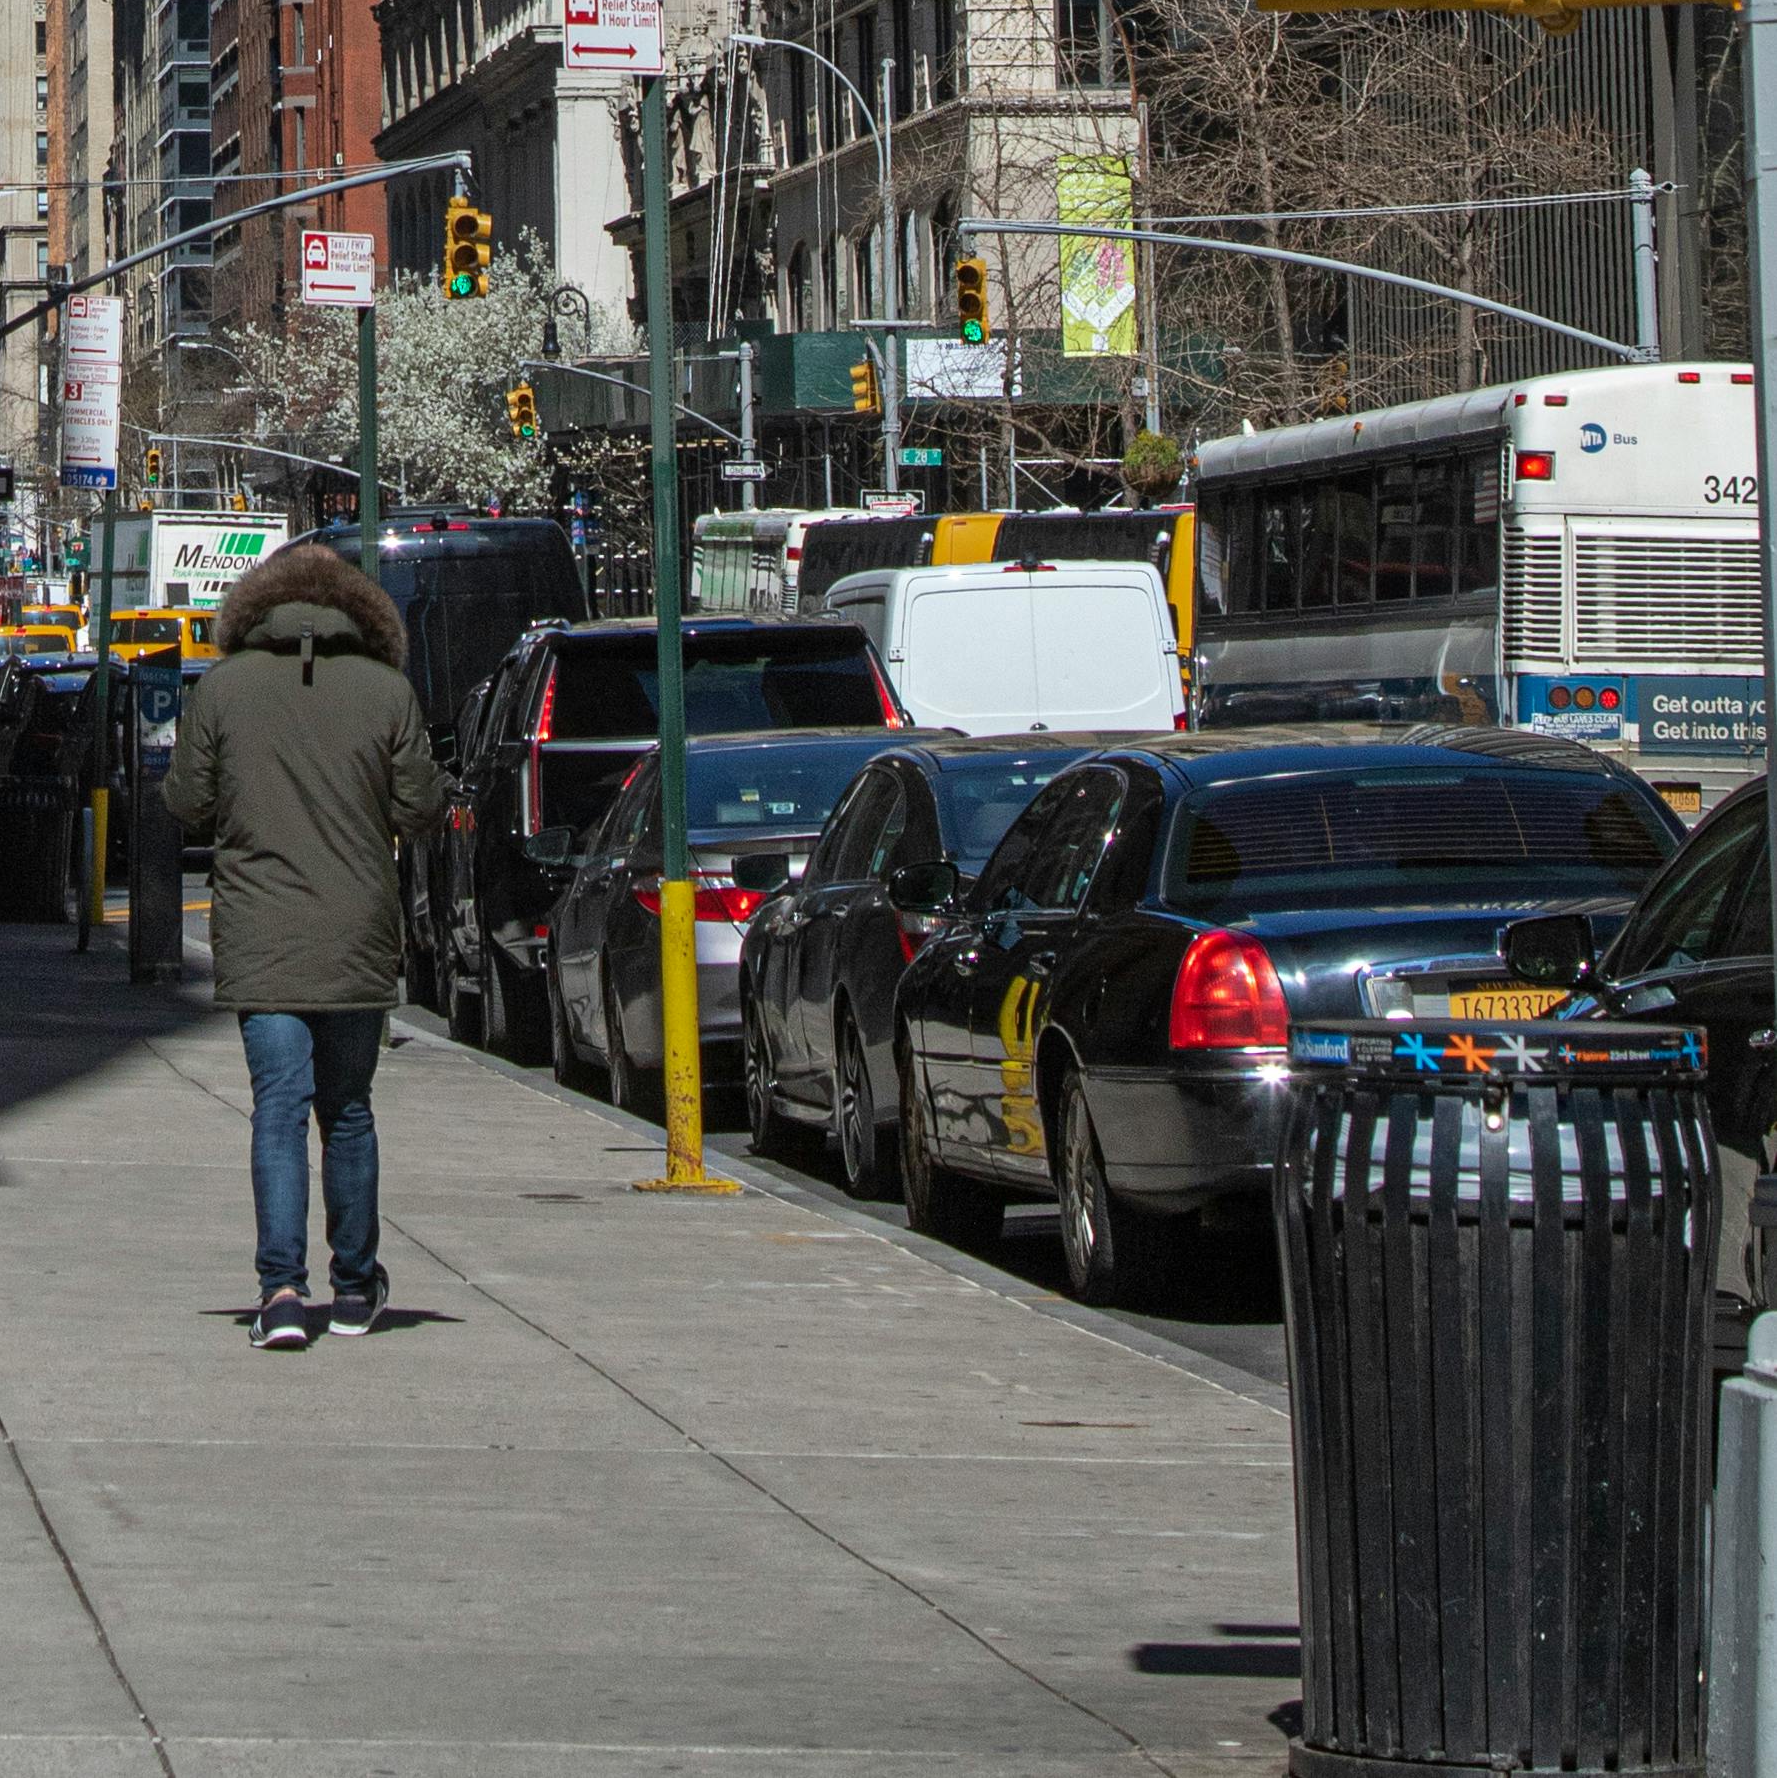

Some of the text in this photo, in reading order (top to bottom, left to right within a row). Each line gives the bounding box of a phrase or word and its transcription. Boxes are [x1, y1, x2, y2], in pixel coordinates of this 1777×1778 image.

[631, 0, 656, 12] Stand
[609, 14, 630, 27] Hour
[633, 15, 656, 28] Limit
[331, 239, 344, 249] Taxi
[331, 250, 370, 261] Relief Stand
[335, 262, 351, 272] Hour
[354, 263, 370, 273] Limit
[69, 383, 78, 399] 3
[66, 408, 107, 417] COMMERCIAL
[66, 417, 112, 426] VEHICLES ONLY
[1579, 429, 1638, 448] MTA Bus
[903, 450, 910, 463] E
[914, 450, 928, 463] 28
[62, 473, 93, 485] 105174
[153, 690, 172, 718] P
[1653, 695, 1689, 714] Get
[1691, 695, 1743, 714] outta
[1594, 716, 1618, 724] CLEAR
[1653, 721, 1689, 740] Get
[1692, 722, 1729, 740] into
[1477, 981, 1537, 990] NEW YORK
[1357, 1054, 1392, 1062] NEW YORK
[1610, 1050, 1627, 1061] 23rd
[1629, 1050, 1650, 1061] Street
